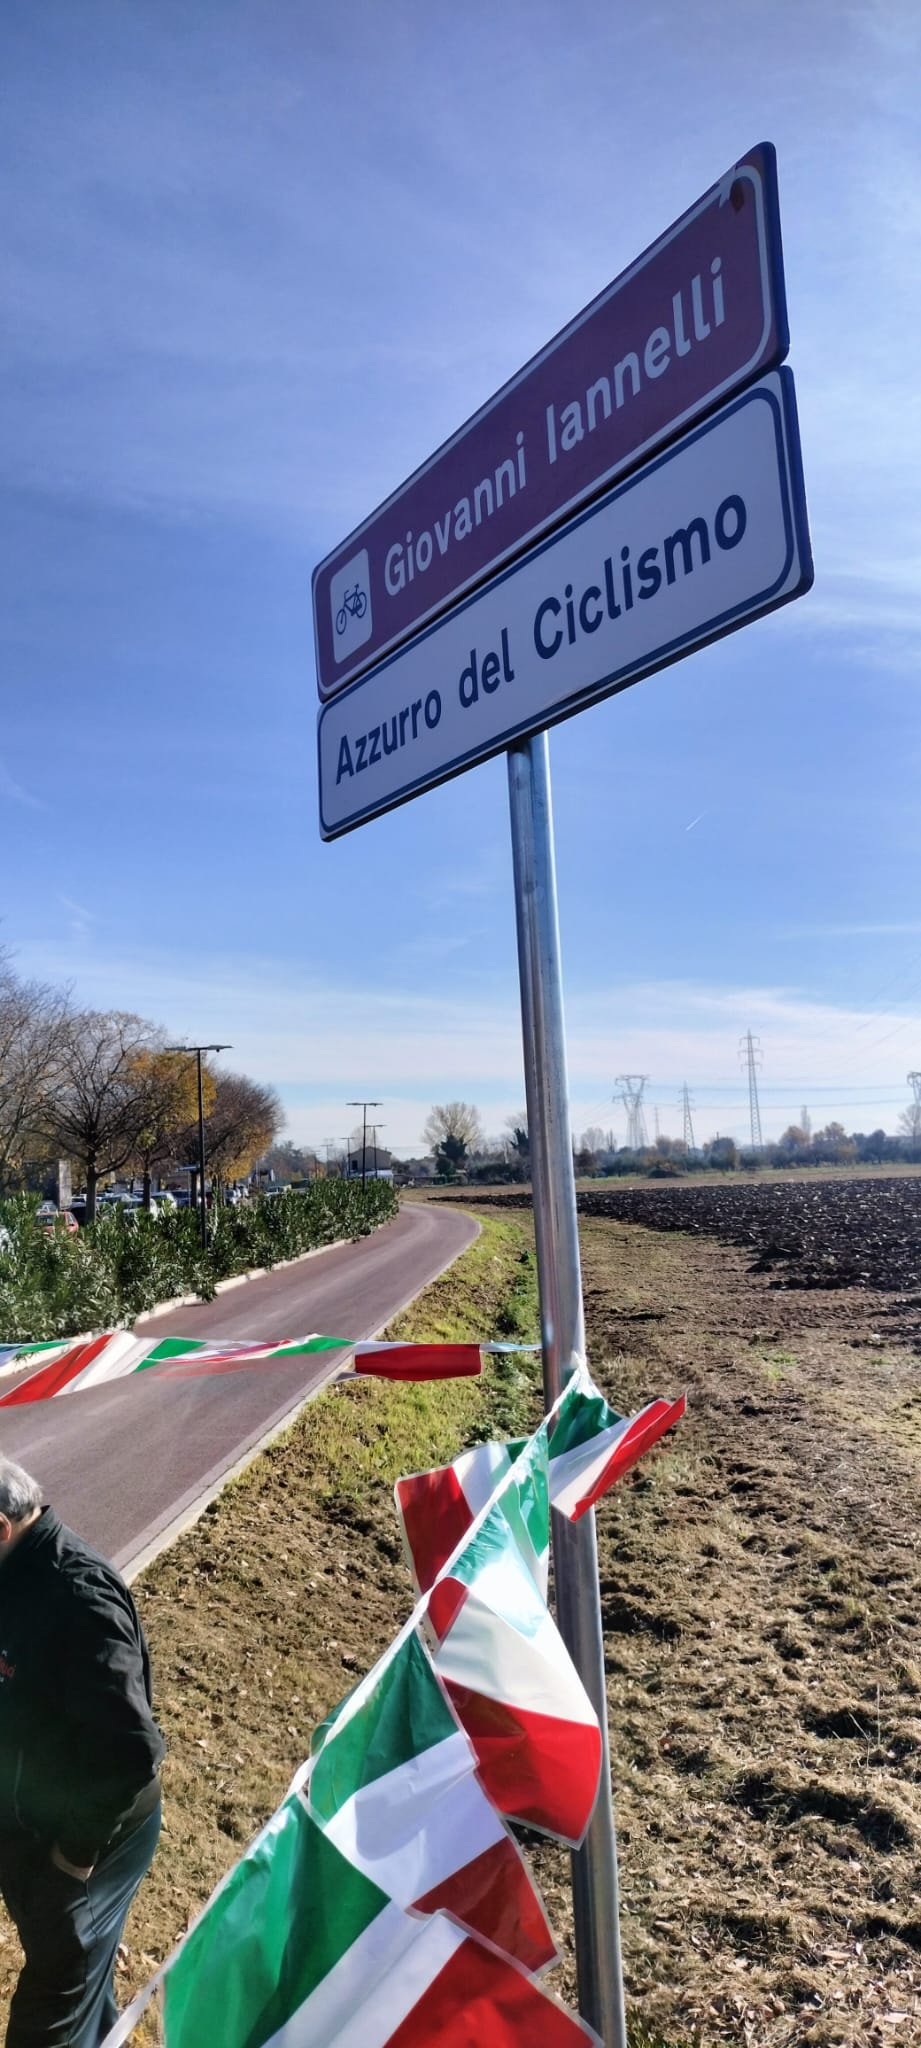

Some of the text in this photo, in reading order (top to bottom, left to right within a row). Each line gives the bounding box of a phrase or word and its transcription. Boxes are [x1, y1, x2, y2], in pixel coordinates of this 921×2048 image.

[384, 256, 725, 596] Giovanni Iannelli
[336, 494, 747, 785] Azzurro del Ciclismo
